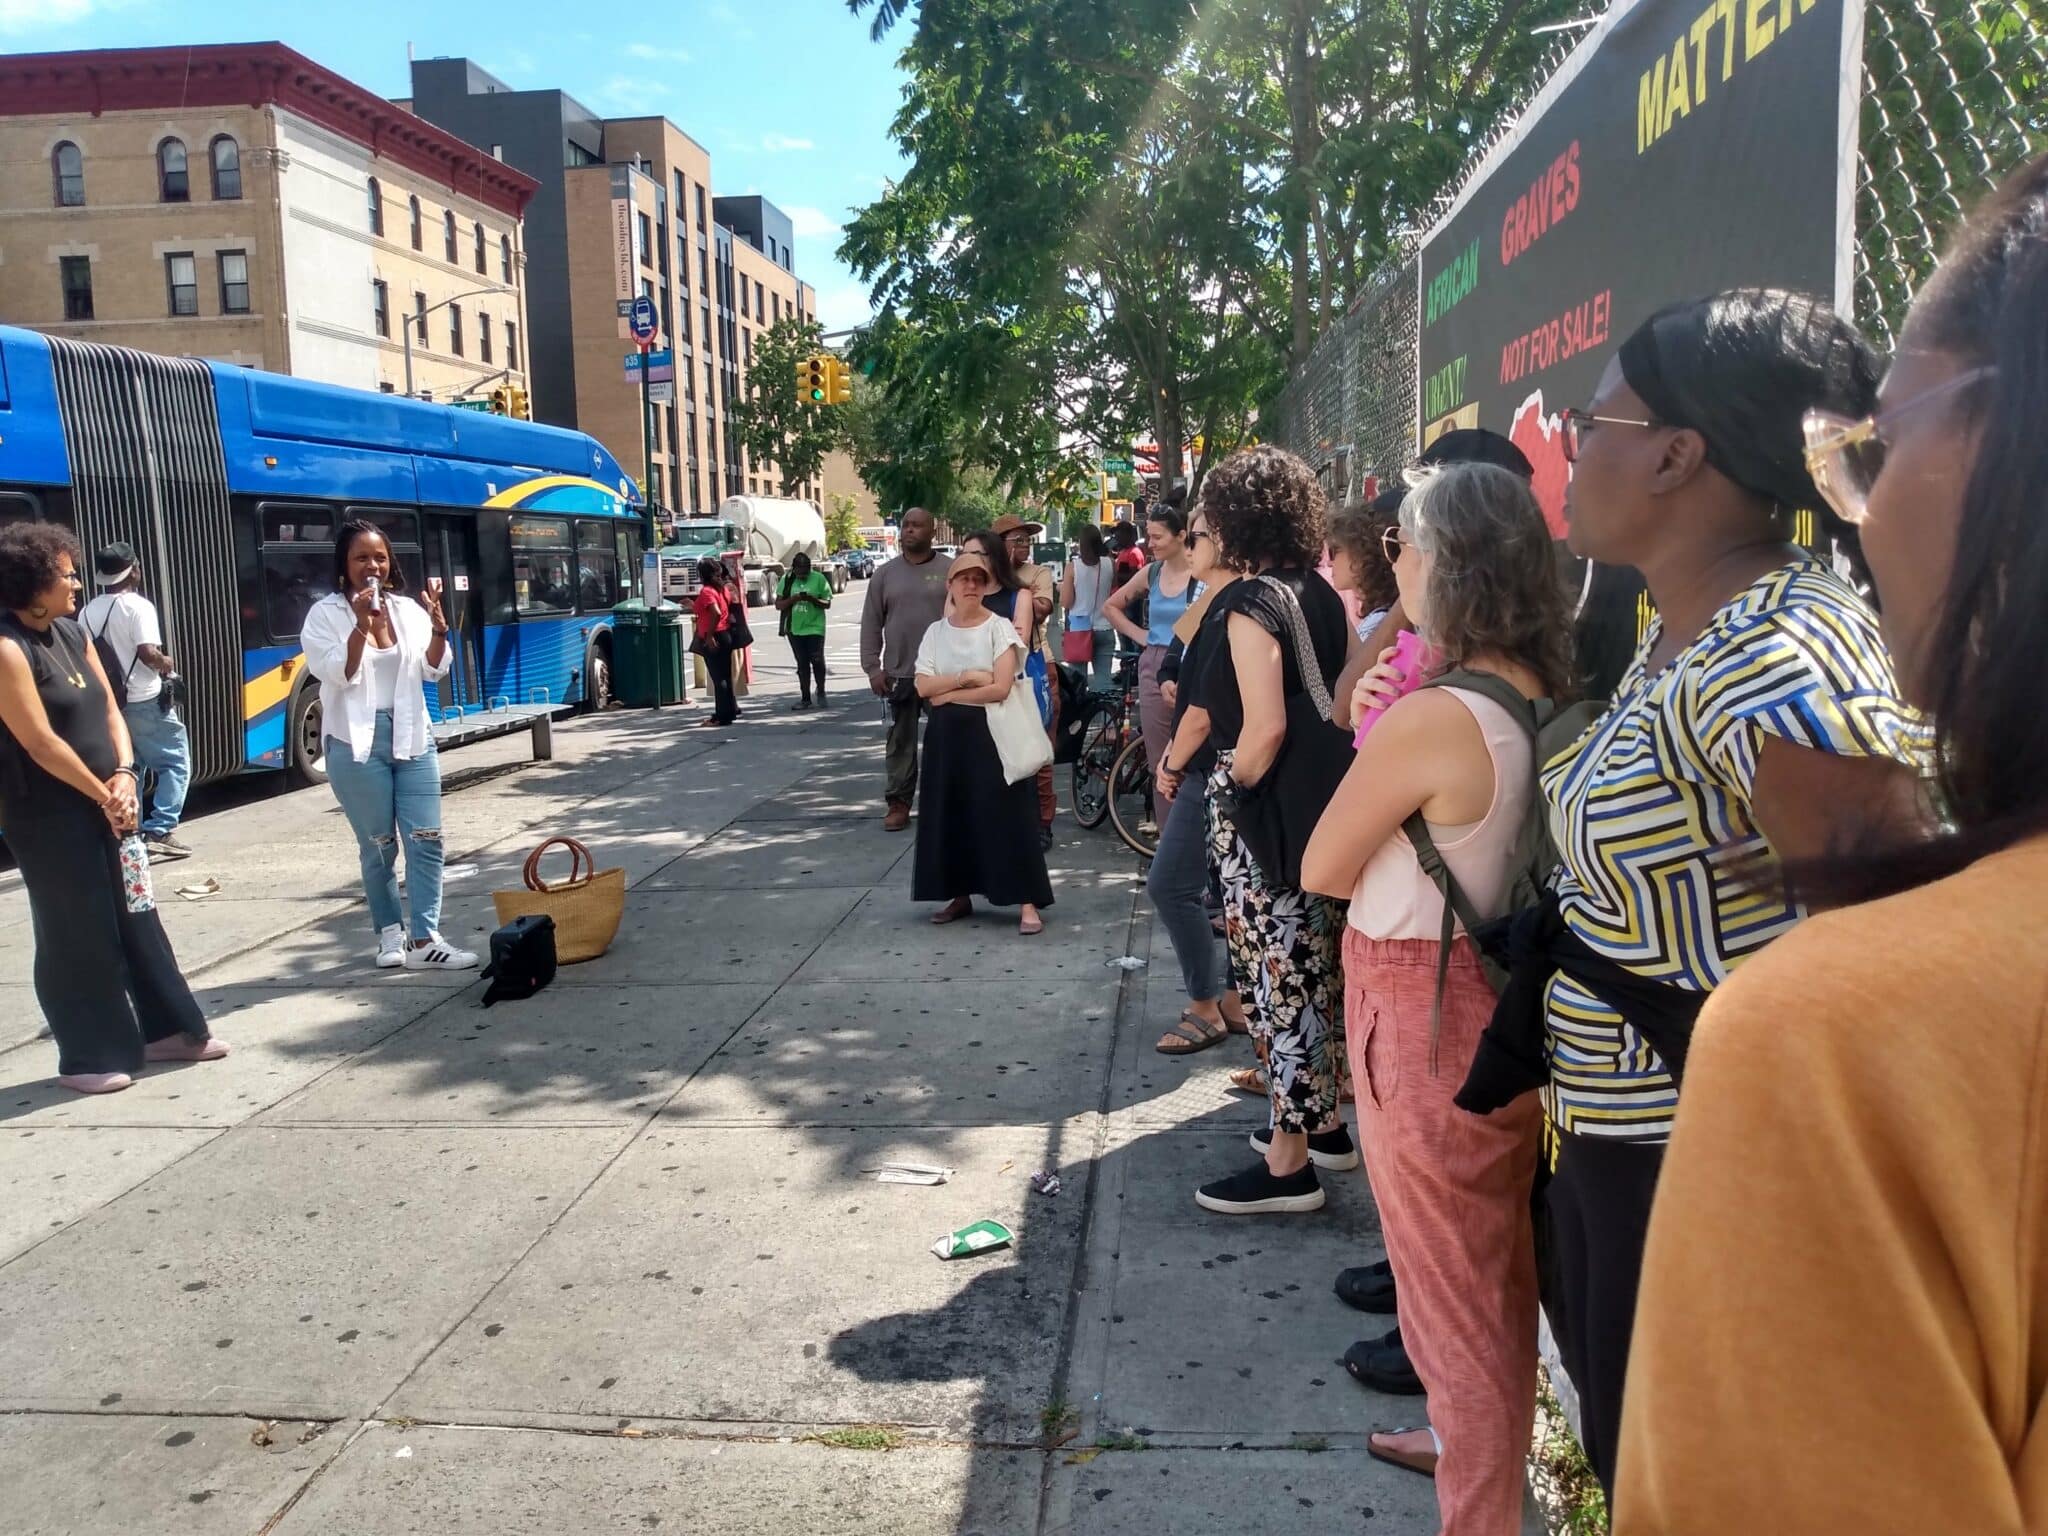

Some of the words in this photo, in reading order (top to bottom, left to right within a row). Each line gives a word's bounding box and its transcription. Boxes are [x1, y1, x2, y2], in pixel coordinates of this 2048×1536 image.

[1426, 236, 1480, 328] AFRICAN
[1501, 139, 1581, 267] GRAVES
[1500, 335, 1529, 385] NOT
[1529, 319, 1559, 374] FOR
[1561, 288, 1611, 361] SALE!
[1425, 353, 1468, 422] URGENT!
